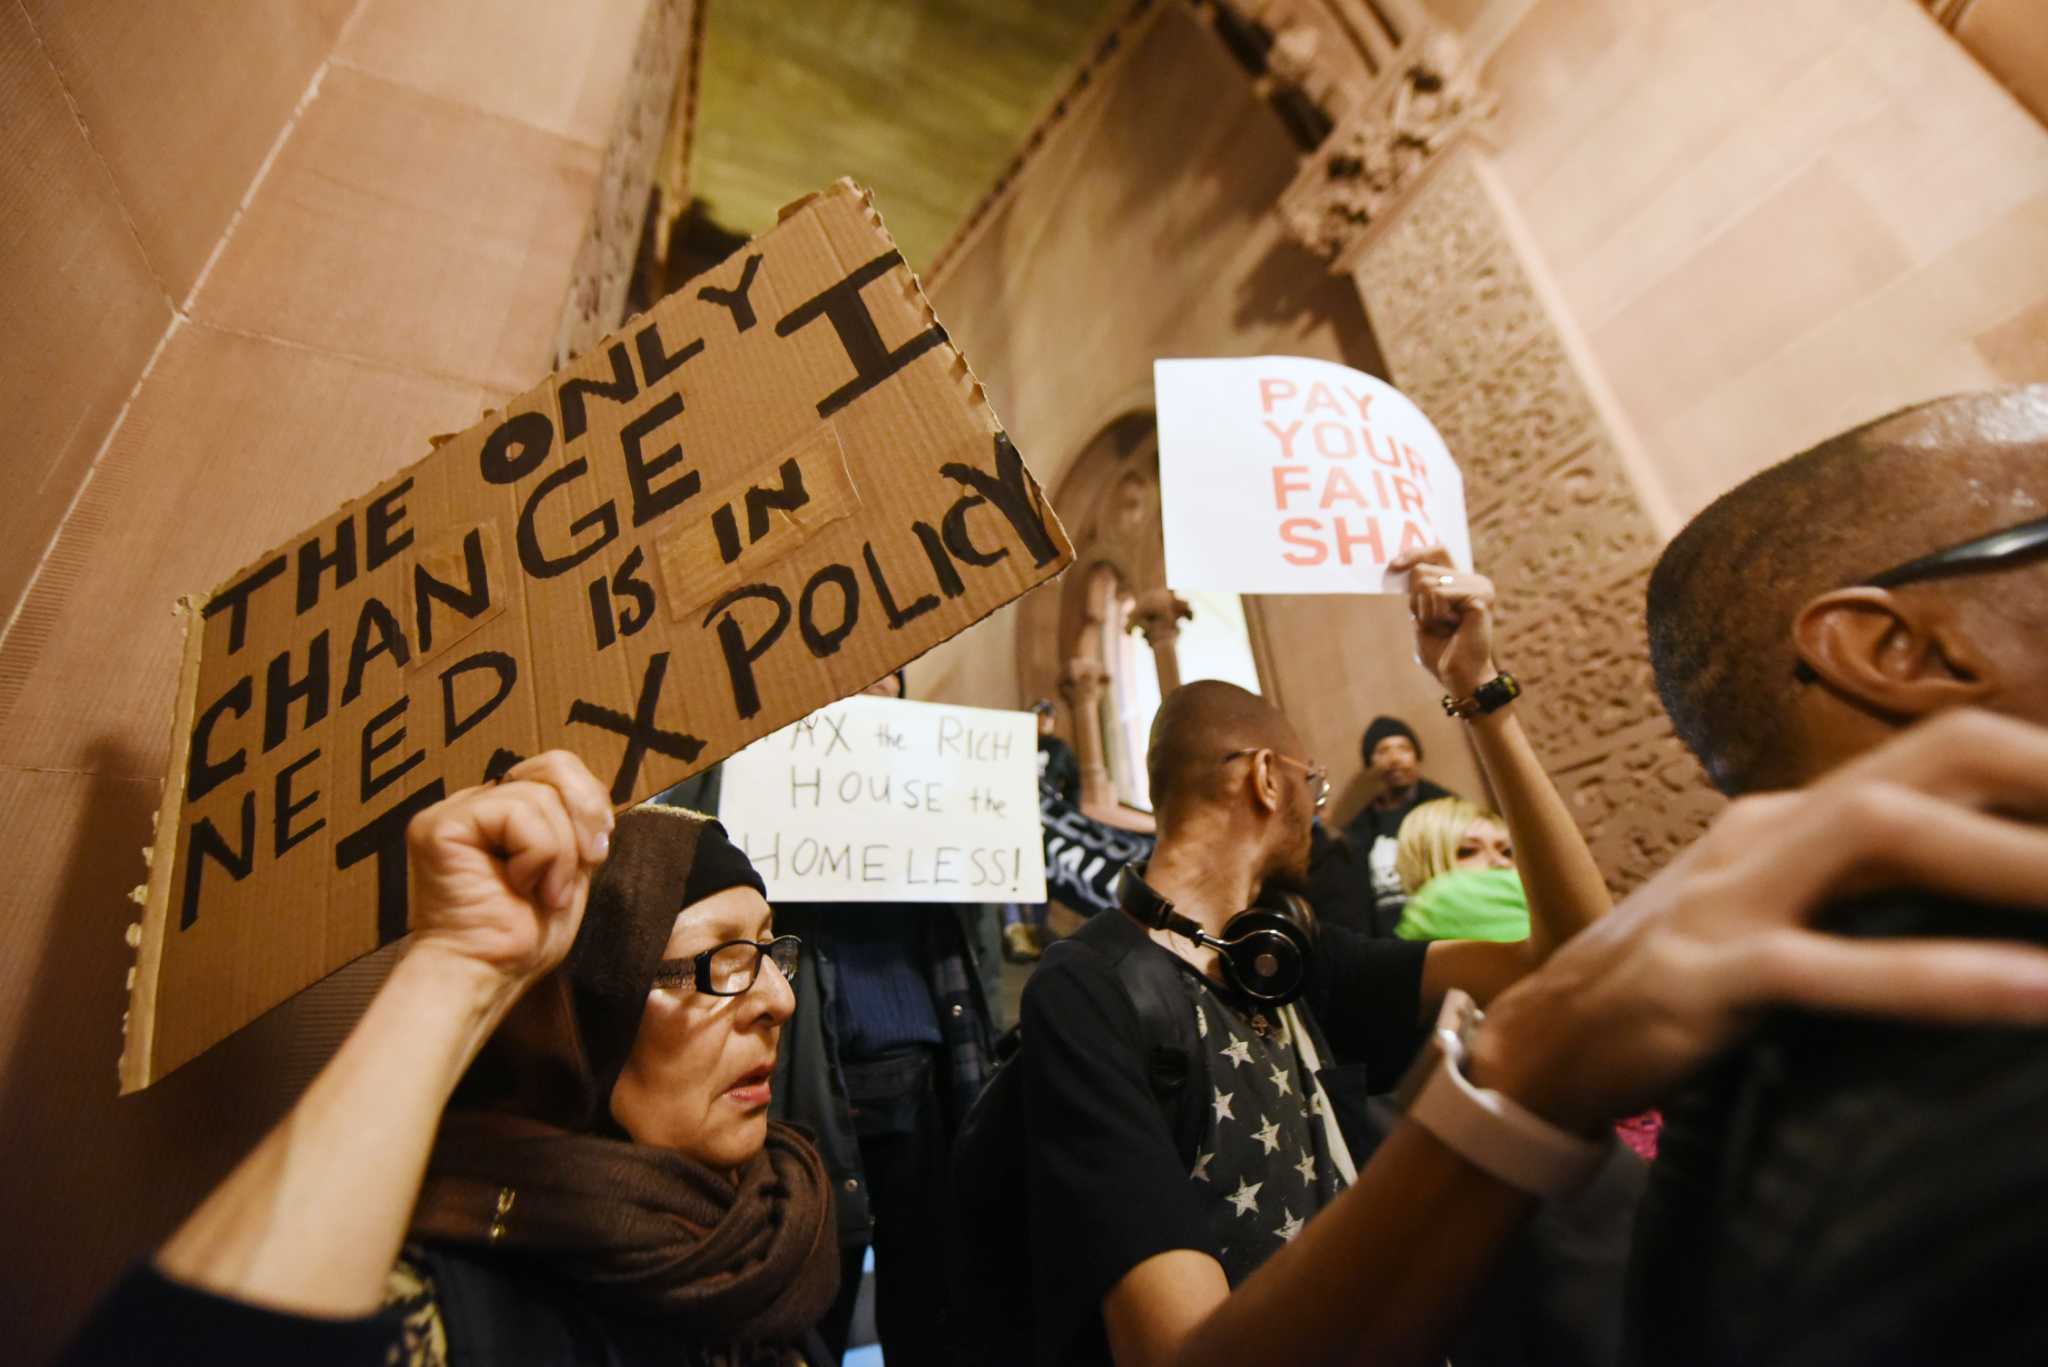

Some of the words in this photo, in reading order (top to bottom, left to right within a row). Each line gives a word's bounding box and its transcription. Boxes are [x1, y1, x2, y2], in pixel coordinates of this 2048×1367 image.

[1258, 378, 1374, 422] PAY
[201, 477, 414, 655] THE
[480, 254, 764, 485] ONLY
[1262, 420, 1431, 490] YOUR
[186, 392, 701, 803] CHANGE
[774, 248, 951, 420] I
[1272, 465, 1431, 522] FAIR
[180, 651, 517, 932] NEED
[588, 545, 656, 651] IS
[711, 457, 811, 564] IN
[336, 651, 708, 947] TX
[702, 430, 1061, 721] POLICY
[764, 711, 852, 757] AX
[873, 728, 907, 751] the
[938, 715, 1014, 763] RICH
[790, 766, 944, 813] HOUSE
[969, 790, 1008, 820] the
[743, 831, 1022, 892] HOMELESS!
